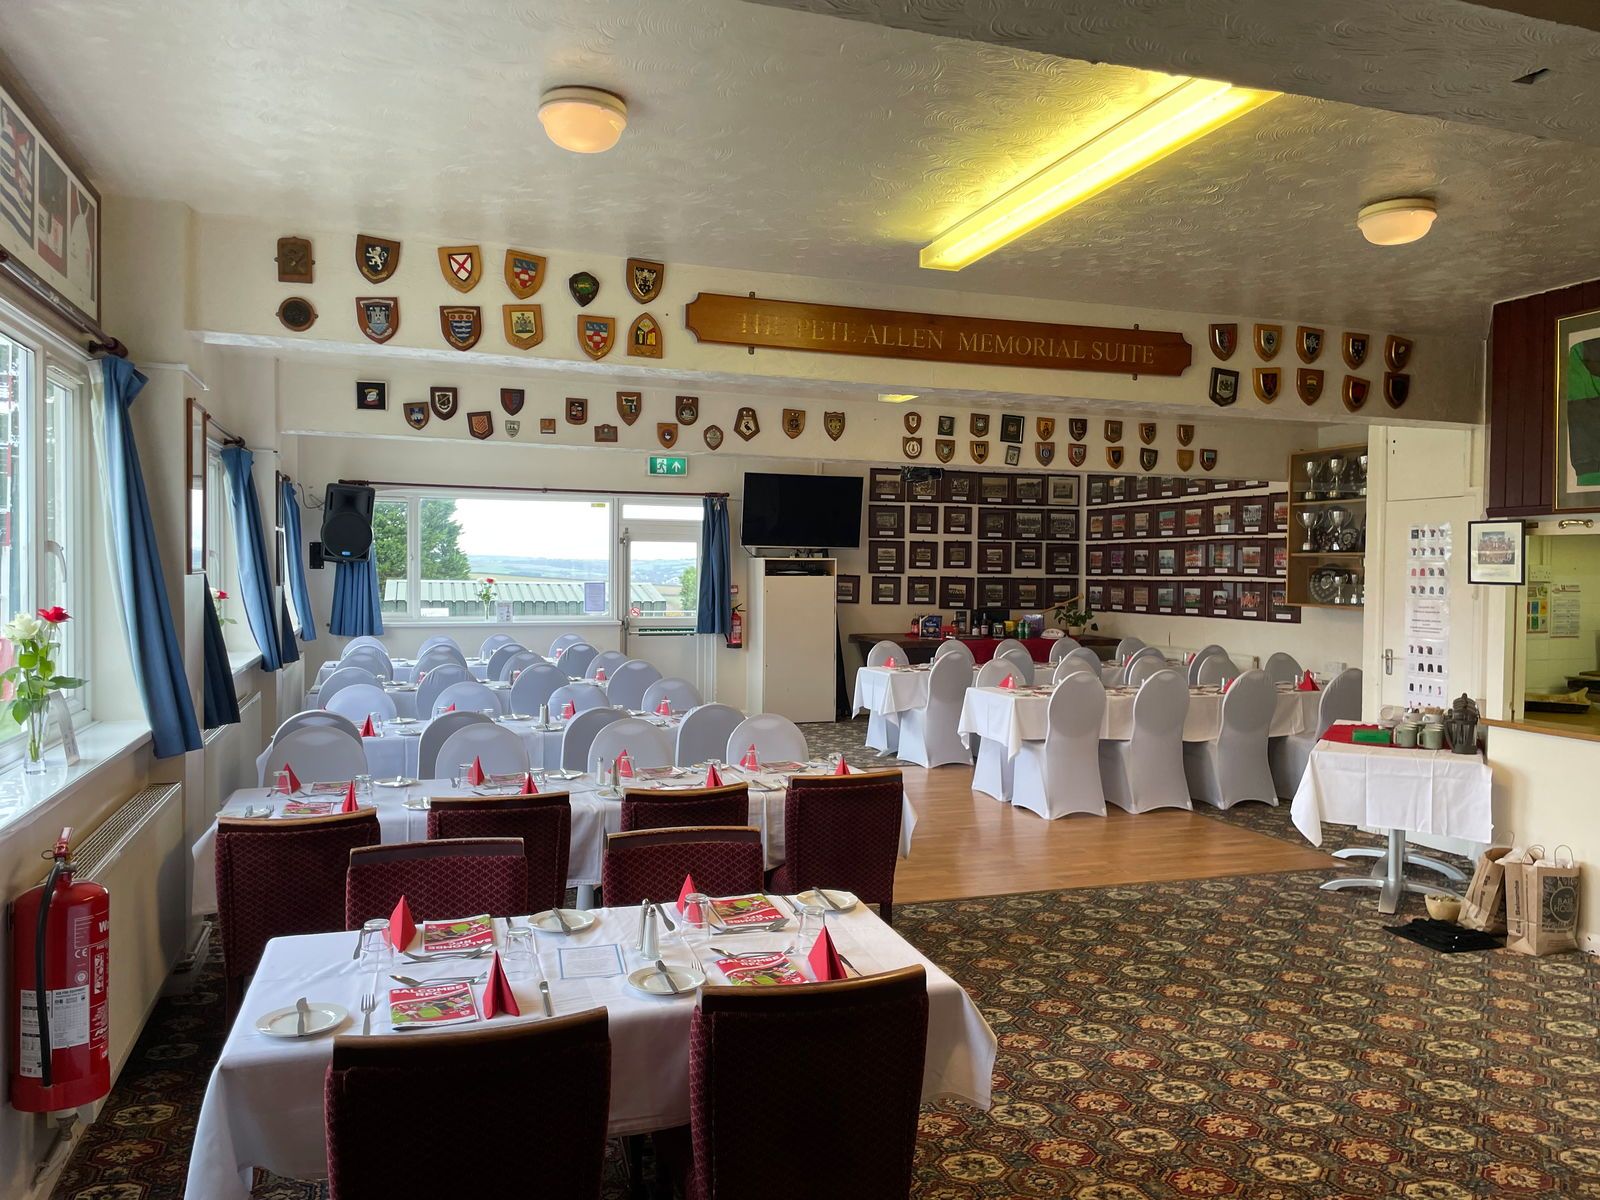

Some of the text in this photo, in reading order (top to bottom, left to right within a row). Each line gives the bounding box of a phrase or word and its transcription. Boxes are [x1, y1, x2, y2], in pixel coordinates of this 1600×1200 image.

[863, 324, 943, 350] ALLEN
[958, 332, 1086, 359] MEMORIAL
[1091, 341, 1155, 364] SUITE
[391, 984, 464, 994] SALCOMBE
